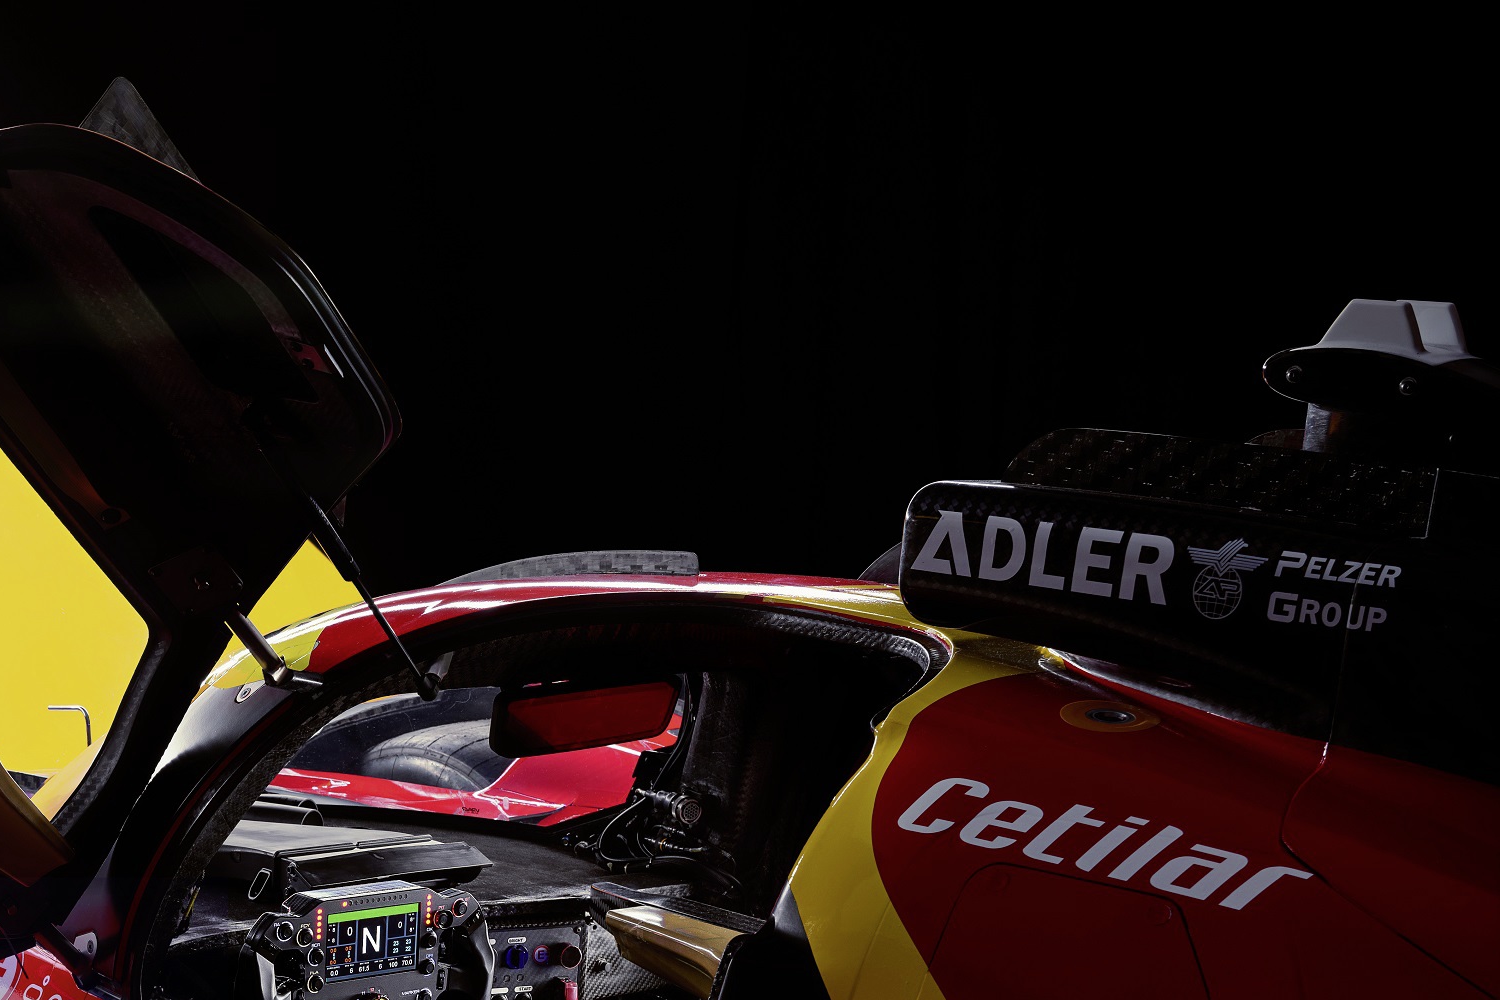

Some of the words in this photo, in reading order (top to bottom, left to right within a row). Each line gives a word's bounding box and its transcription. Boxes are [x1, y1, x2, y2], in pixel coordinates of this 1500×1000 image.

[910, 510, 1175, 606] ADLER
[1274, 550, 1402, 588] PELZER
[1267, 591, 1388, 632] GROUP
[897, 777, 1314, 911] Cetilar
[362, 925, 381, 954] N
